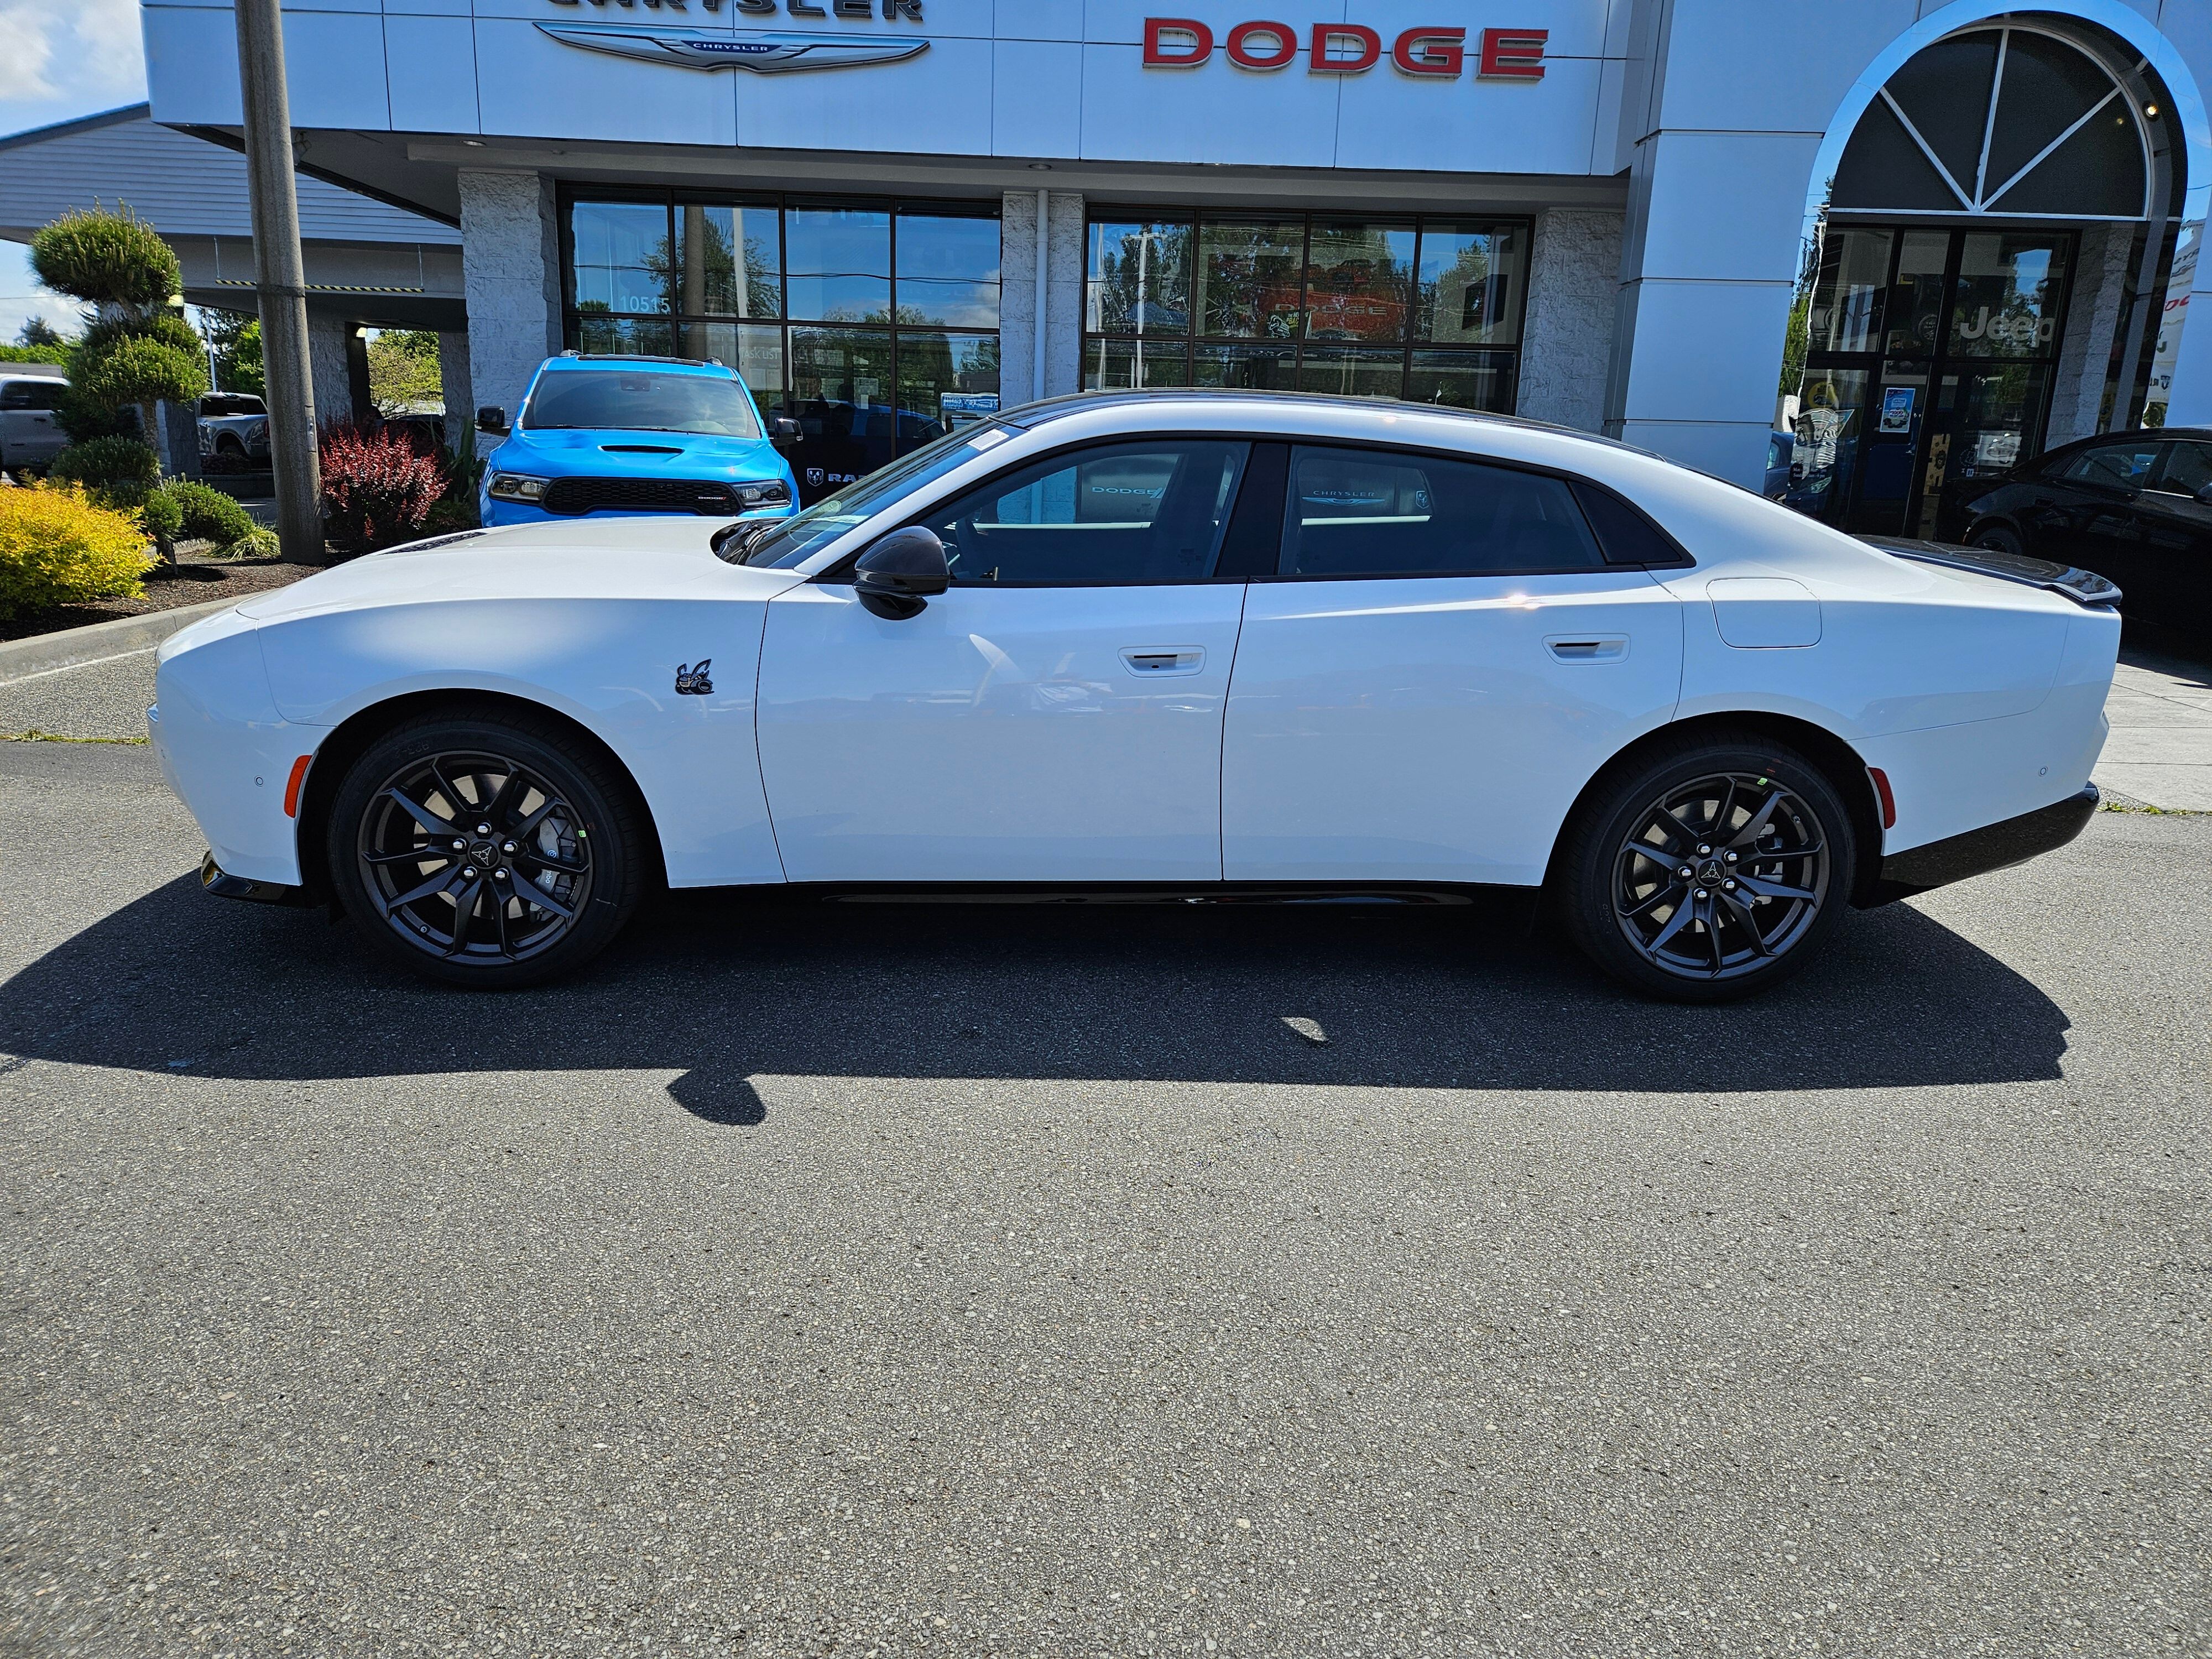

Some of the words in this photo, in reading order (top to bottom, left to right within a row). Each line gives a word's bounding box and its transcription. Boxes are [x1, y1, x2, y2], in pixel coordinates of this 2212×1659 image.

[693, 43, 768, 51] CHRYSLER
[1142, 17, 1549, 80] DODGE
[620, 295, 671, 315] 10515
[1960, 306, 2056, 348] Jeep
[739, 349, 761, 359] TASK
[763, 349, 779, 359] LIST
[1092, 486, 1157, 495] DODGE
